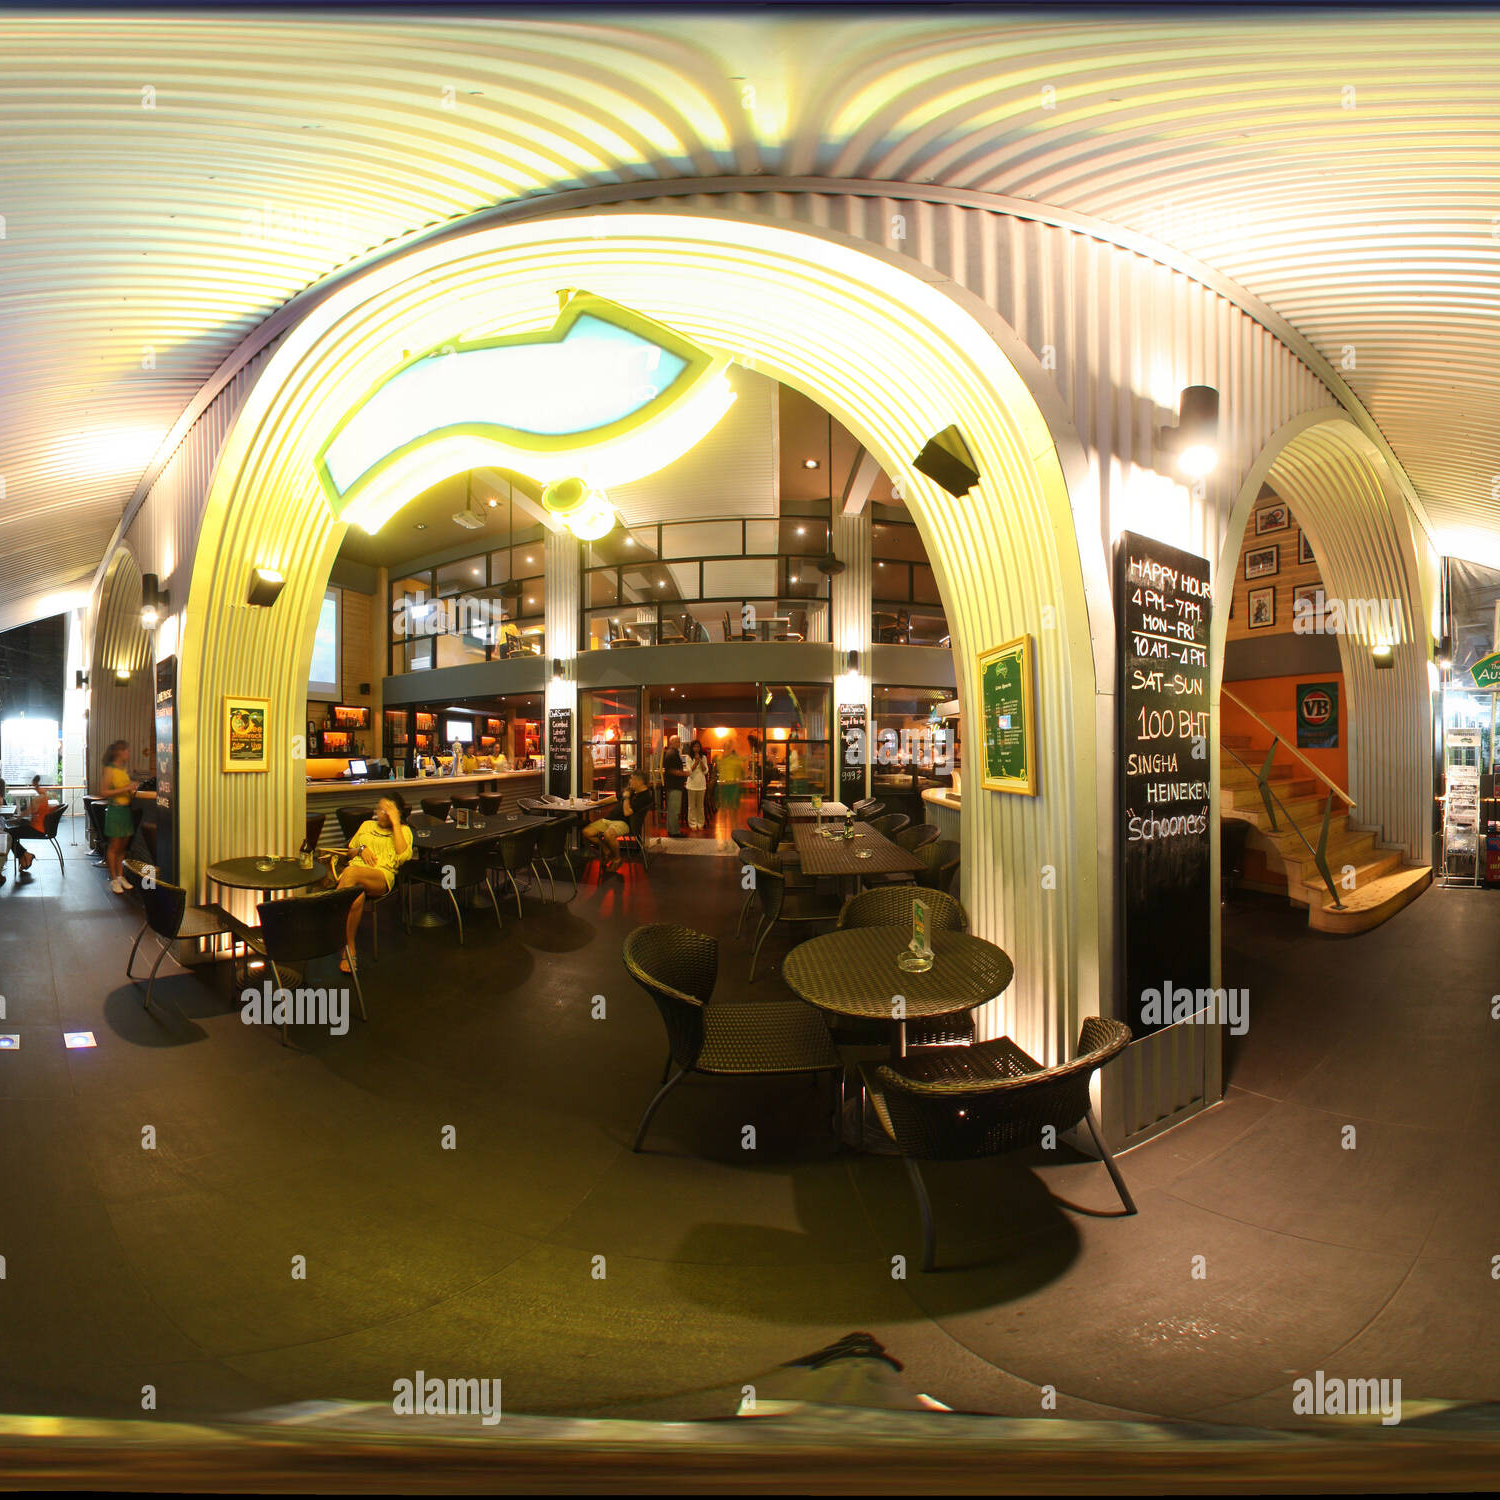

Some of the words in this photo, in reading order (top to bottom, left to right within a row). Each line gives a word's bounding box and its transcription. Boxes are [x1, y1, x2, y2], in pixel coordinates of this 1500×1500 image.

[1130, 555, 1178, 590] HAPPY
[1181, 574, 1211, 599] HOUR
[1142, 613, 1195, 641] MON-FRI
[1131, 670, 1203, 696] SAT-SUN
[1303, 700, 1330, 717] VB
[1137, 705, 1175, 740] 100
[1179, 710, 1211, 739] BHT
[1126, 752, 1179, 775] SINGHA
[1147, 782, 1211, 802] HEINEKEN
